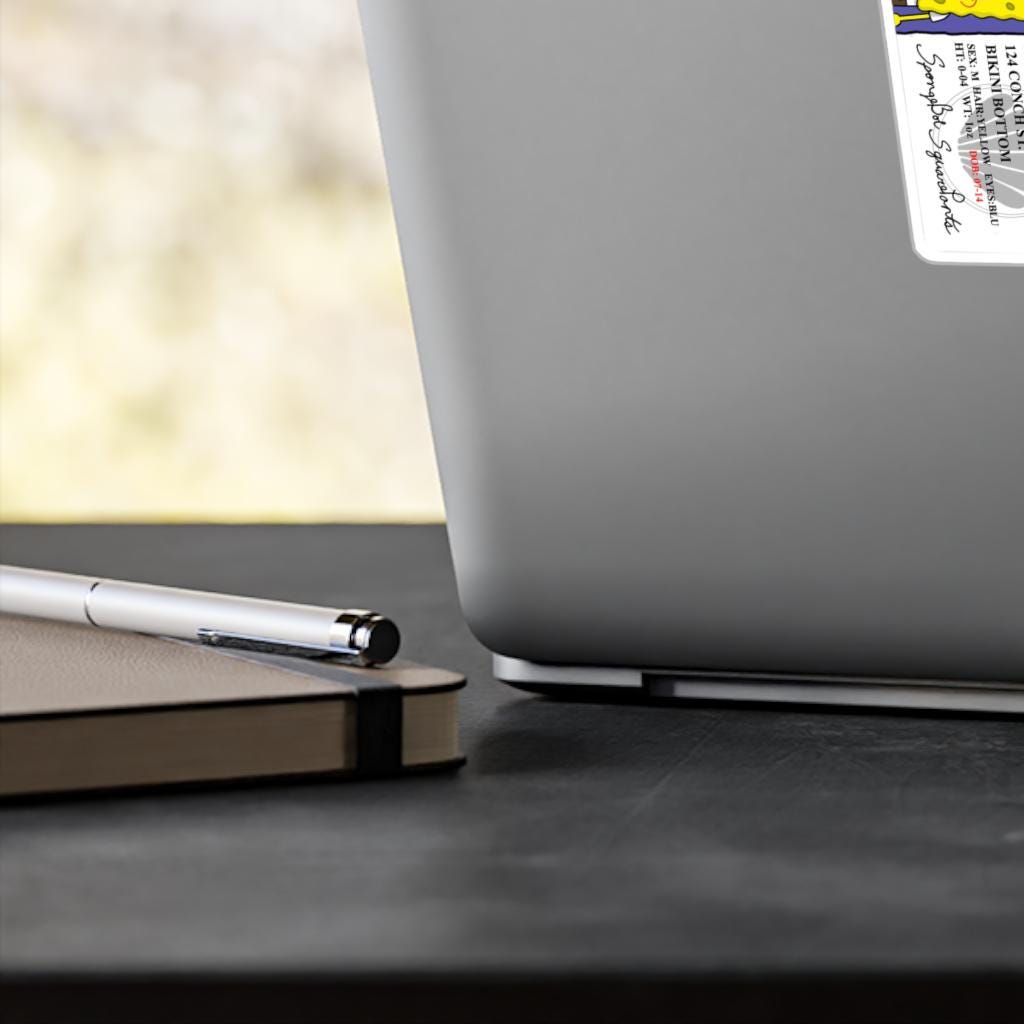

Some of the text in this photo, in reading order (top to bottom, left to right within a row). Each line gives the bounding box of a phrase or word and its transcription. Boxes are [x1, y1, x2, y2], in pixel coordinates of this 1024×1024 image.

[954, 42, 965, 62] HT:
[966, 44, 976, 68] SEX:
[1005, 45, 1018, 67] 124
[958, 65, 968, 87] 0-04
[970, 71, 980, 81] M
[962, 96, 972, 118] WT:
[985, 45, 1011, 163] BIKINI BOTTOM
[969, 150, 979, 175] DOB:
[973, 178, 983, 202] 07-14
